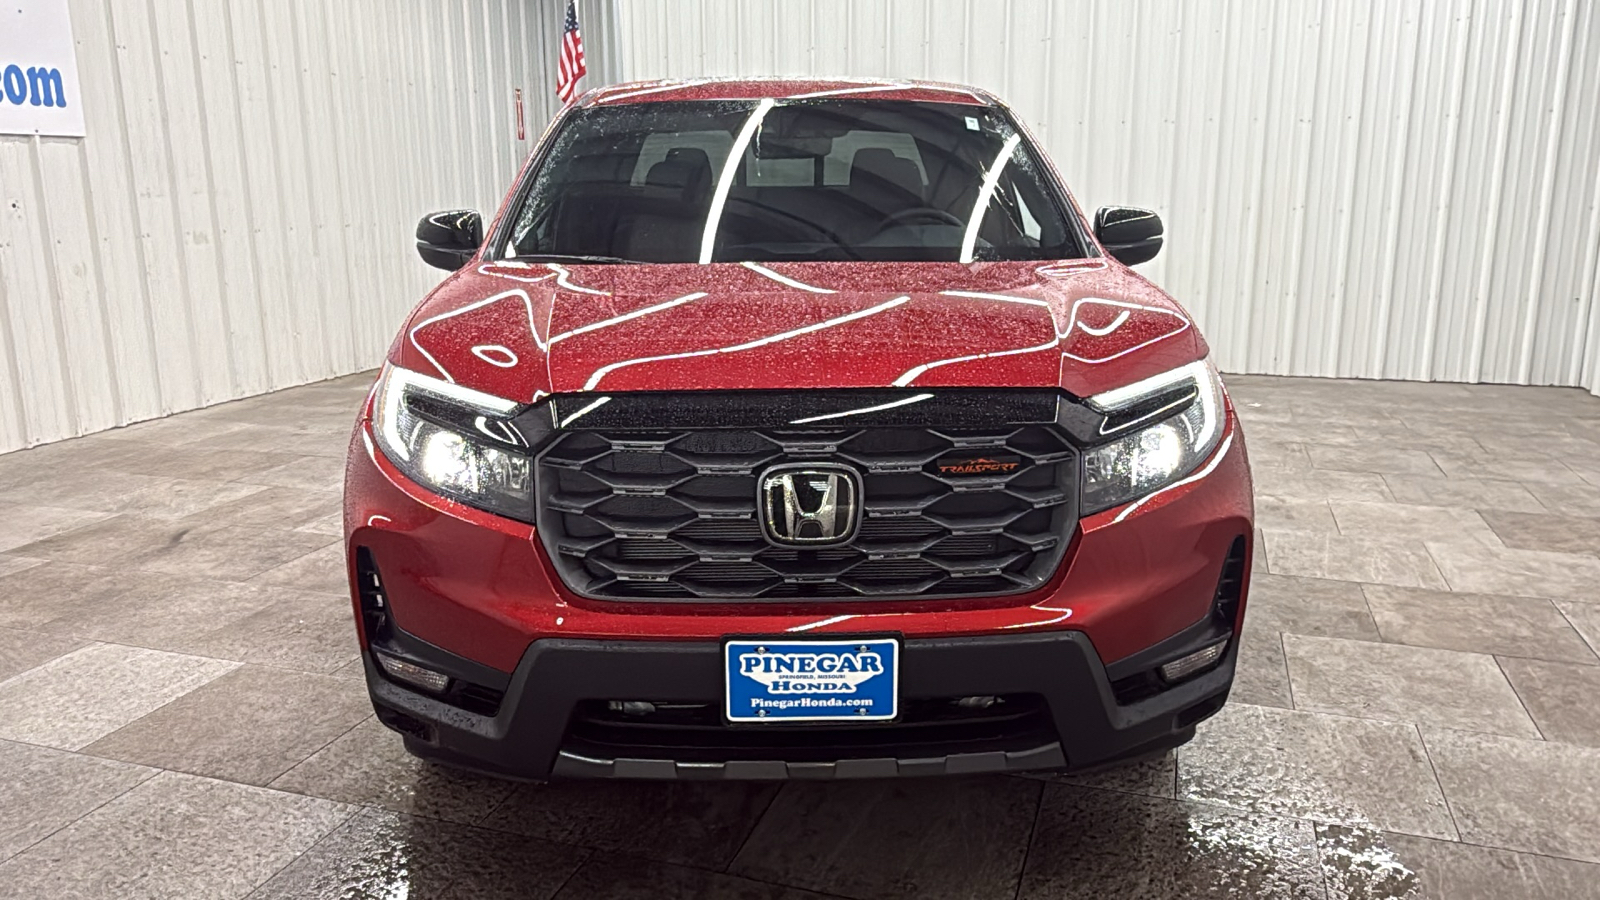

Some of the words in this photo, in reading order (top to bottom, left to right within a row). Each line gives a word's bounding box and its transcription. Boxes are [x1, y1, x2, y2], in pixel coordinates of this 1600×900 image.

[0, 64, 67, 108] om
[939, 463, 1019, 473] TRAILSPORT
[743, 656, 880, 673] PINEGAR
[771, 681, 852, 691] HONDA
[751, 698, 873, 709] PinegarHonda.com
